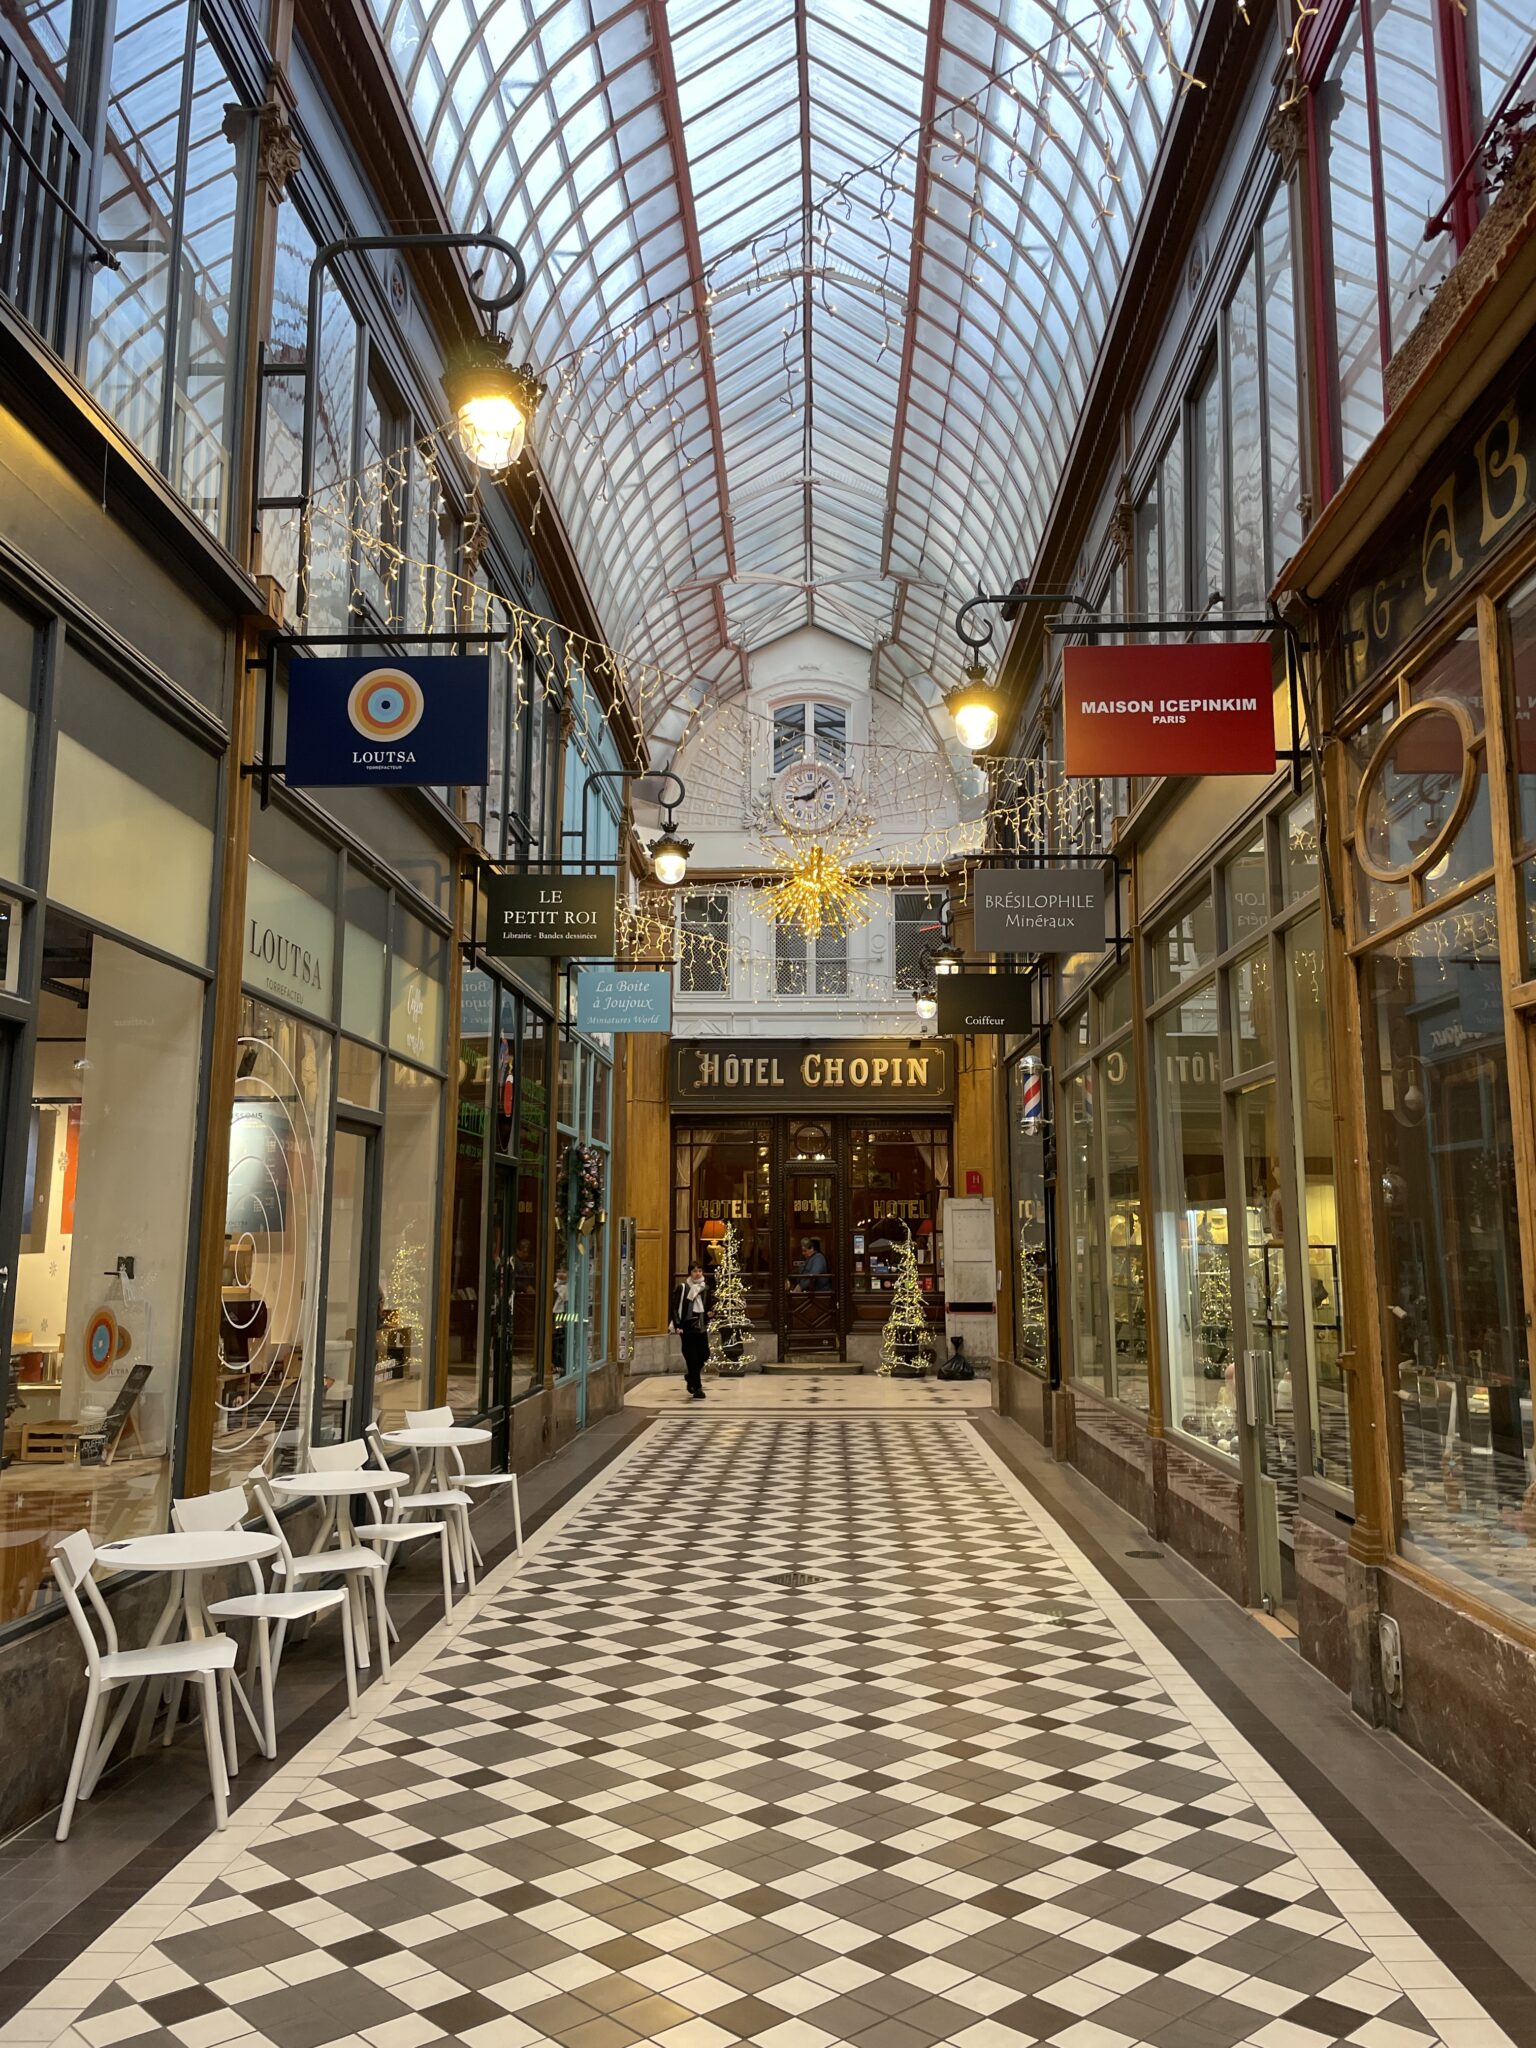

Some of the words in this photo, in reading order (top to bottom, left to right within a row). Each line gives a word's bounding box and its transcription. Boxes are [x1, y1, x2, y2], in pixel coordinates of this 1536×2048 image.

[1081, 700, 1153, 714] MAISON
[1160, 698, 1257, 712] ICEPINKIM
[1152, 715, 1186, 724] PARIS
[352, 751, 417, 763] LOUTSA
[539, 890, 563, 904] LE
[985, 891, 1095, 909] BRÉSILOPHILE
[503, 911, 558, 925] PETIT
[564, 911, 597, 925] ROI
[1005, 912, 1075, 928] Minéraux
[503, 931, 532, 940] Librairie
[538, 931, 564, 940] Bandes
[564, 931, 597, 940] dessinées
[249, 918, 322, 990] LOUTSA
[595, 981, 613, 993] La
[616, 981, 650, 992] Boite
[592, 996, 601, 1009] à
[602, 996, 654, 1015] Joujoux
[586, 1015, 631, 1025] Miniatures
[631, 1014, 659, 1025] World
[965, 1015, 1005, 1026] Coiffeur
[694, 1050, 785, 1087] HÔTEL
[800, 1053, 929, 1088] CHOPIN
[697, 1199, 752, 1219] HOTEL
[873, 1199, 929, 1219] HOTEL
